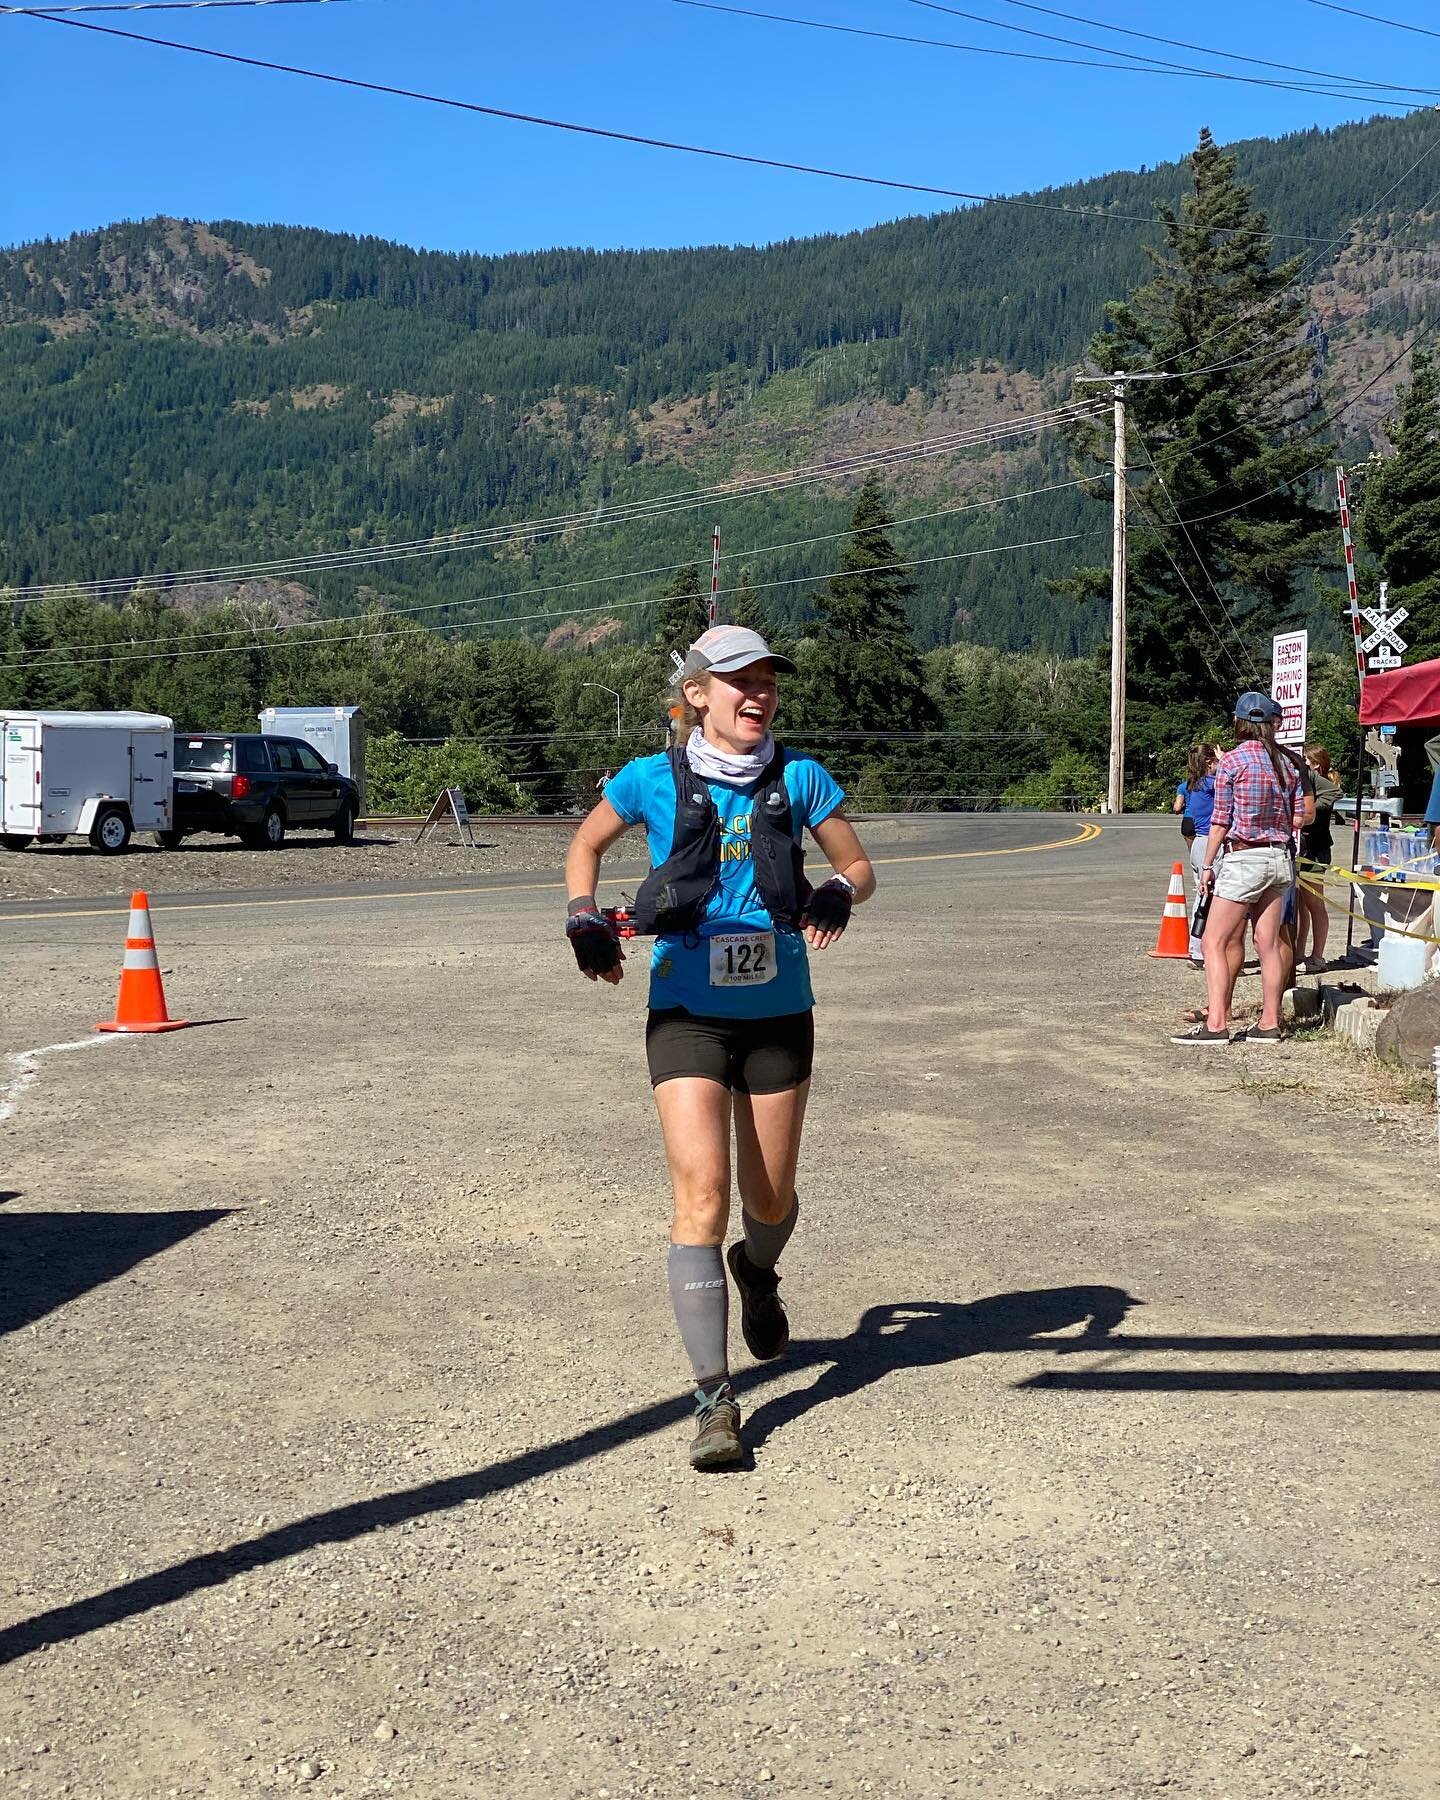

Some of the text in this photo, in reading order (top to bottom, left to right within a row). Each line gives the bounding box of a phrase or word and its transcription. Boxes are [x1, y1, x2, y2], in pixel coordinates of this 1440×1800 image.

[1363, 610, 1406, 650] CROSSING
[1364, 609, 1405, 650] RAIL ROAD
[1277, 642, 1302, 656] EASTON
[1382, 647, 1388, 656] 2
[1277, 657, 1288, 667] FIRE
[1276, 669, 1303, 683] PARKING
[1275, 682, 1302, 701] ONLY
[724, 942, 767, 974] 122
